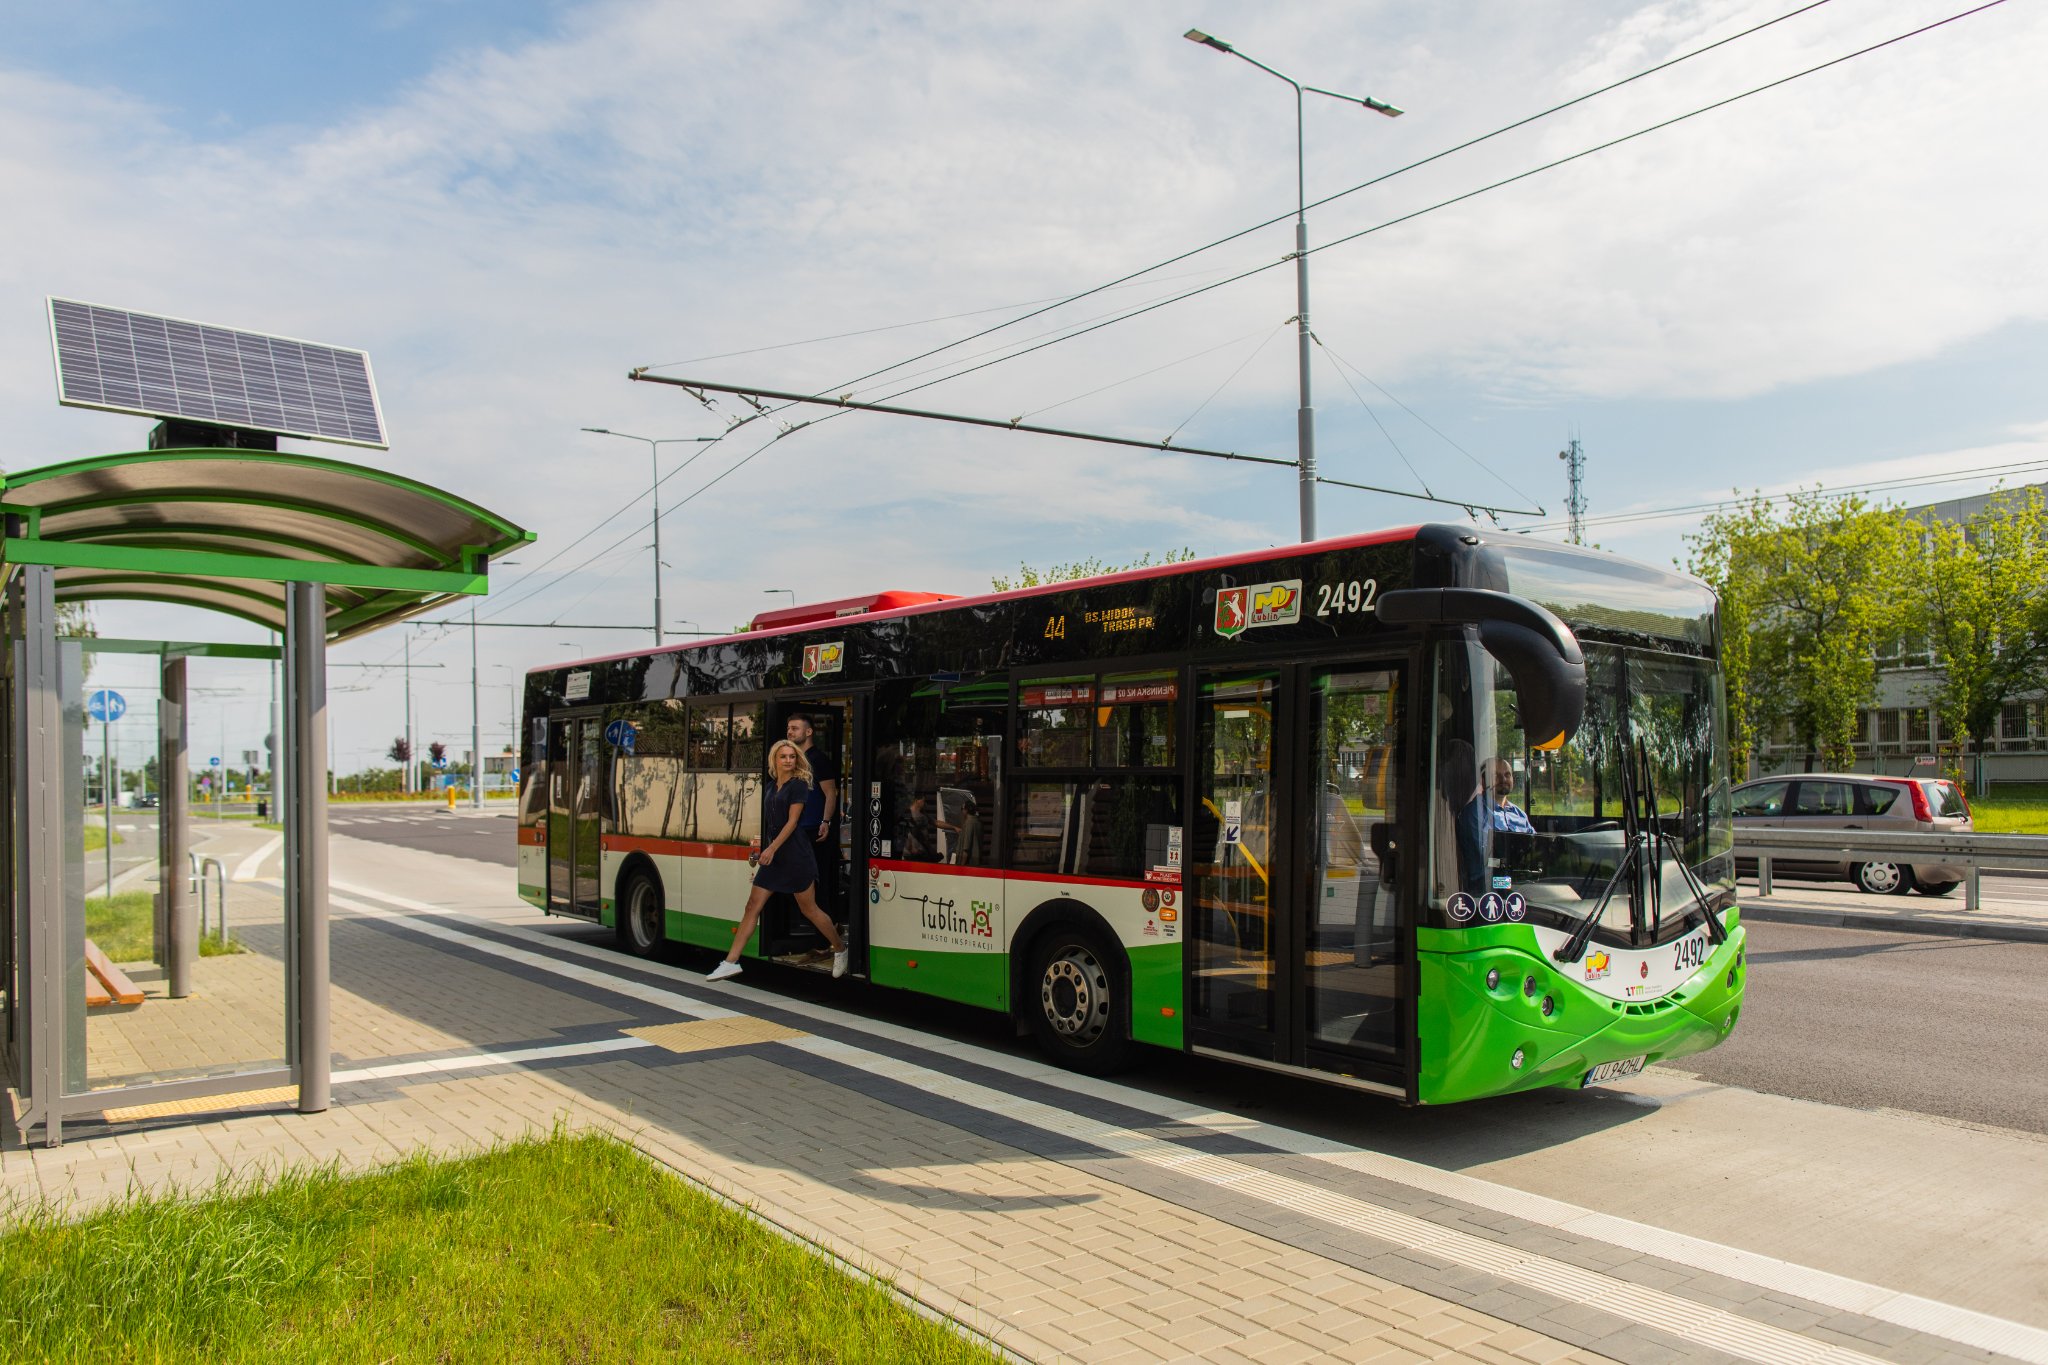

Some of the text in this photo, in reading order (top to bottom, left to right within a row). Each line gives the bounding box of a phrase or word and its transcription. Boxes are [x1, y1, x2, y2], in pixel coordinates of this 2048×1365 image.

[1316, 578, 1377, 617] 2492
[1043, 615, 1065, 641] 44
[1102, 618, 1137, 633] TRASA
[1251, 611, 1279, 623] Lublin
[921, 932, 993, 951] MIASTO INSPIRACJI
[1674, 936, 1704, 971] 2492
[1592, 1056, 1641, 1082] LU 942HL
